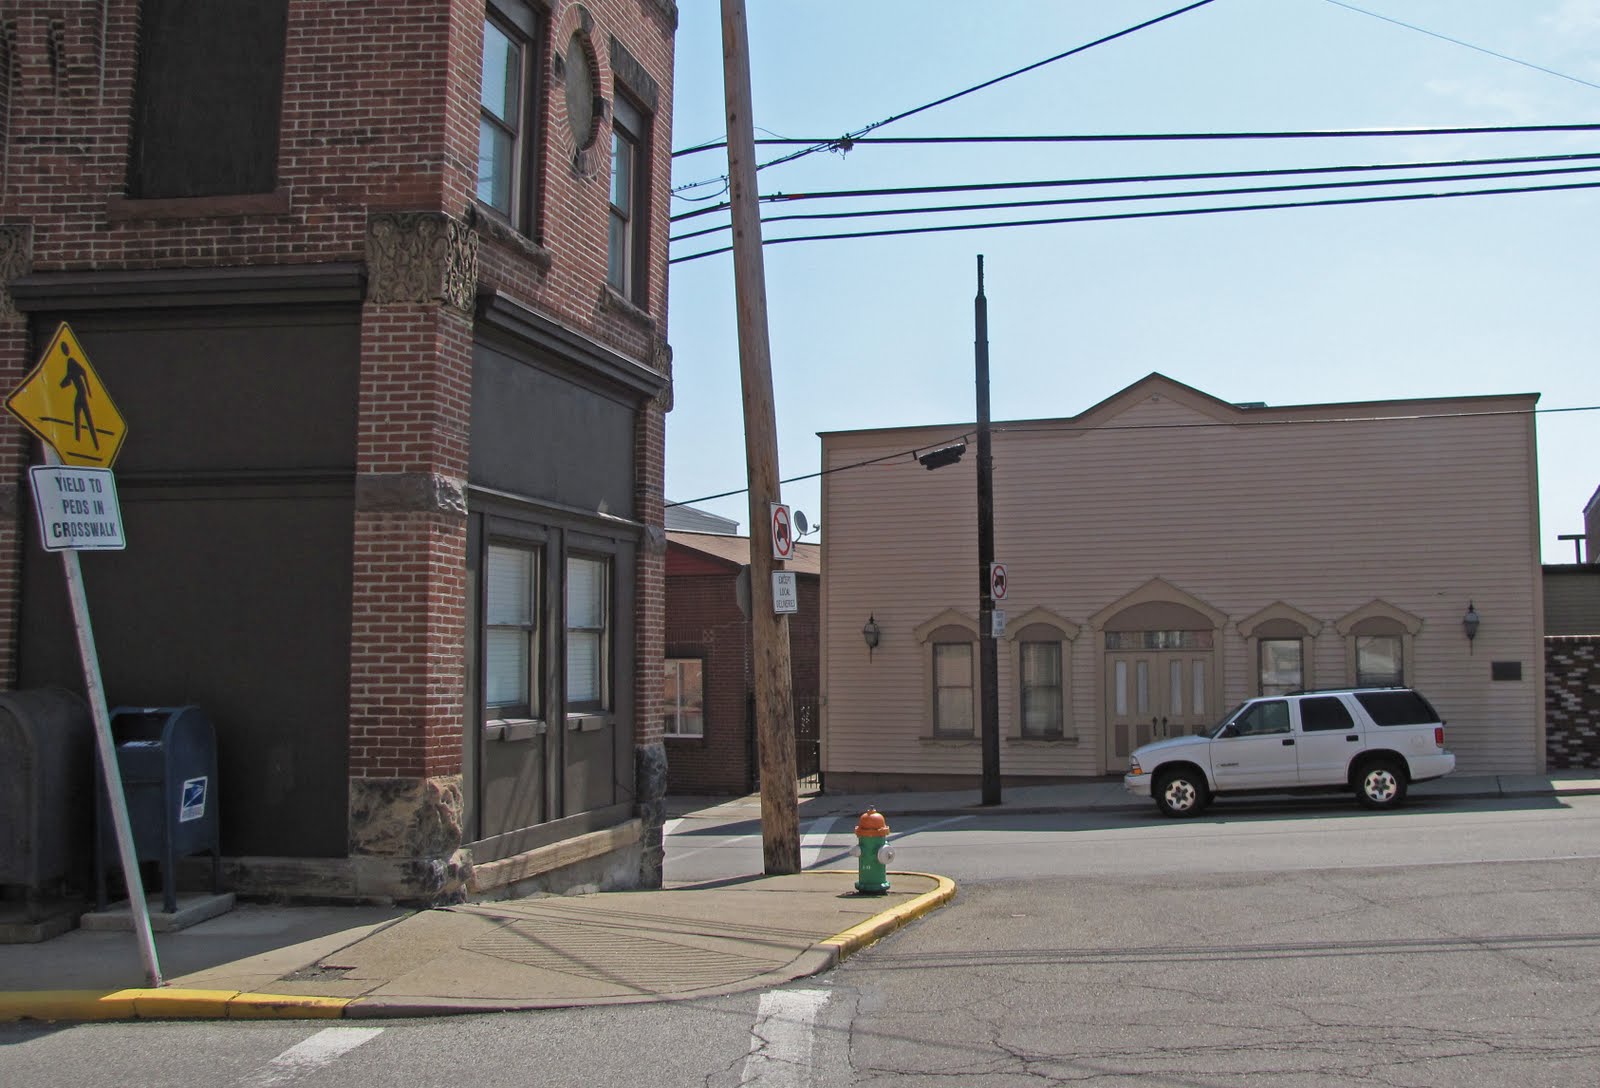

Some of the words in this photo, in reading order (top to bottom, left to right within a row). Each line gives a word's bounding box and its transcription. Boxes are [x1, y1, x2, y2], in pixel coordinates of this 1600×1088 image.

[55, 476, 85, 492] YIELD
[89, 478, 103, 493] TO
[62, 499, 90, 515] PEDS
[93, 500, 105, 515] IN
[52, 522, 117, 538] CROSSWALK
